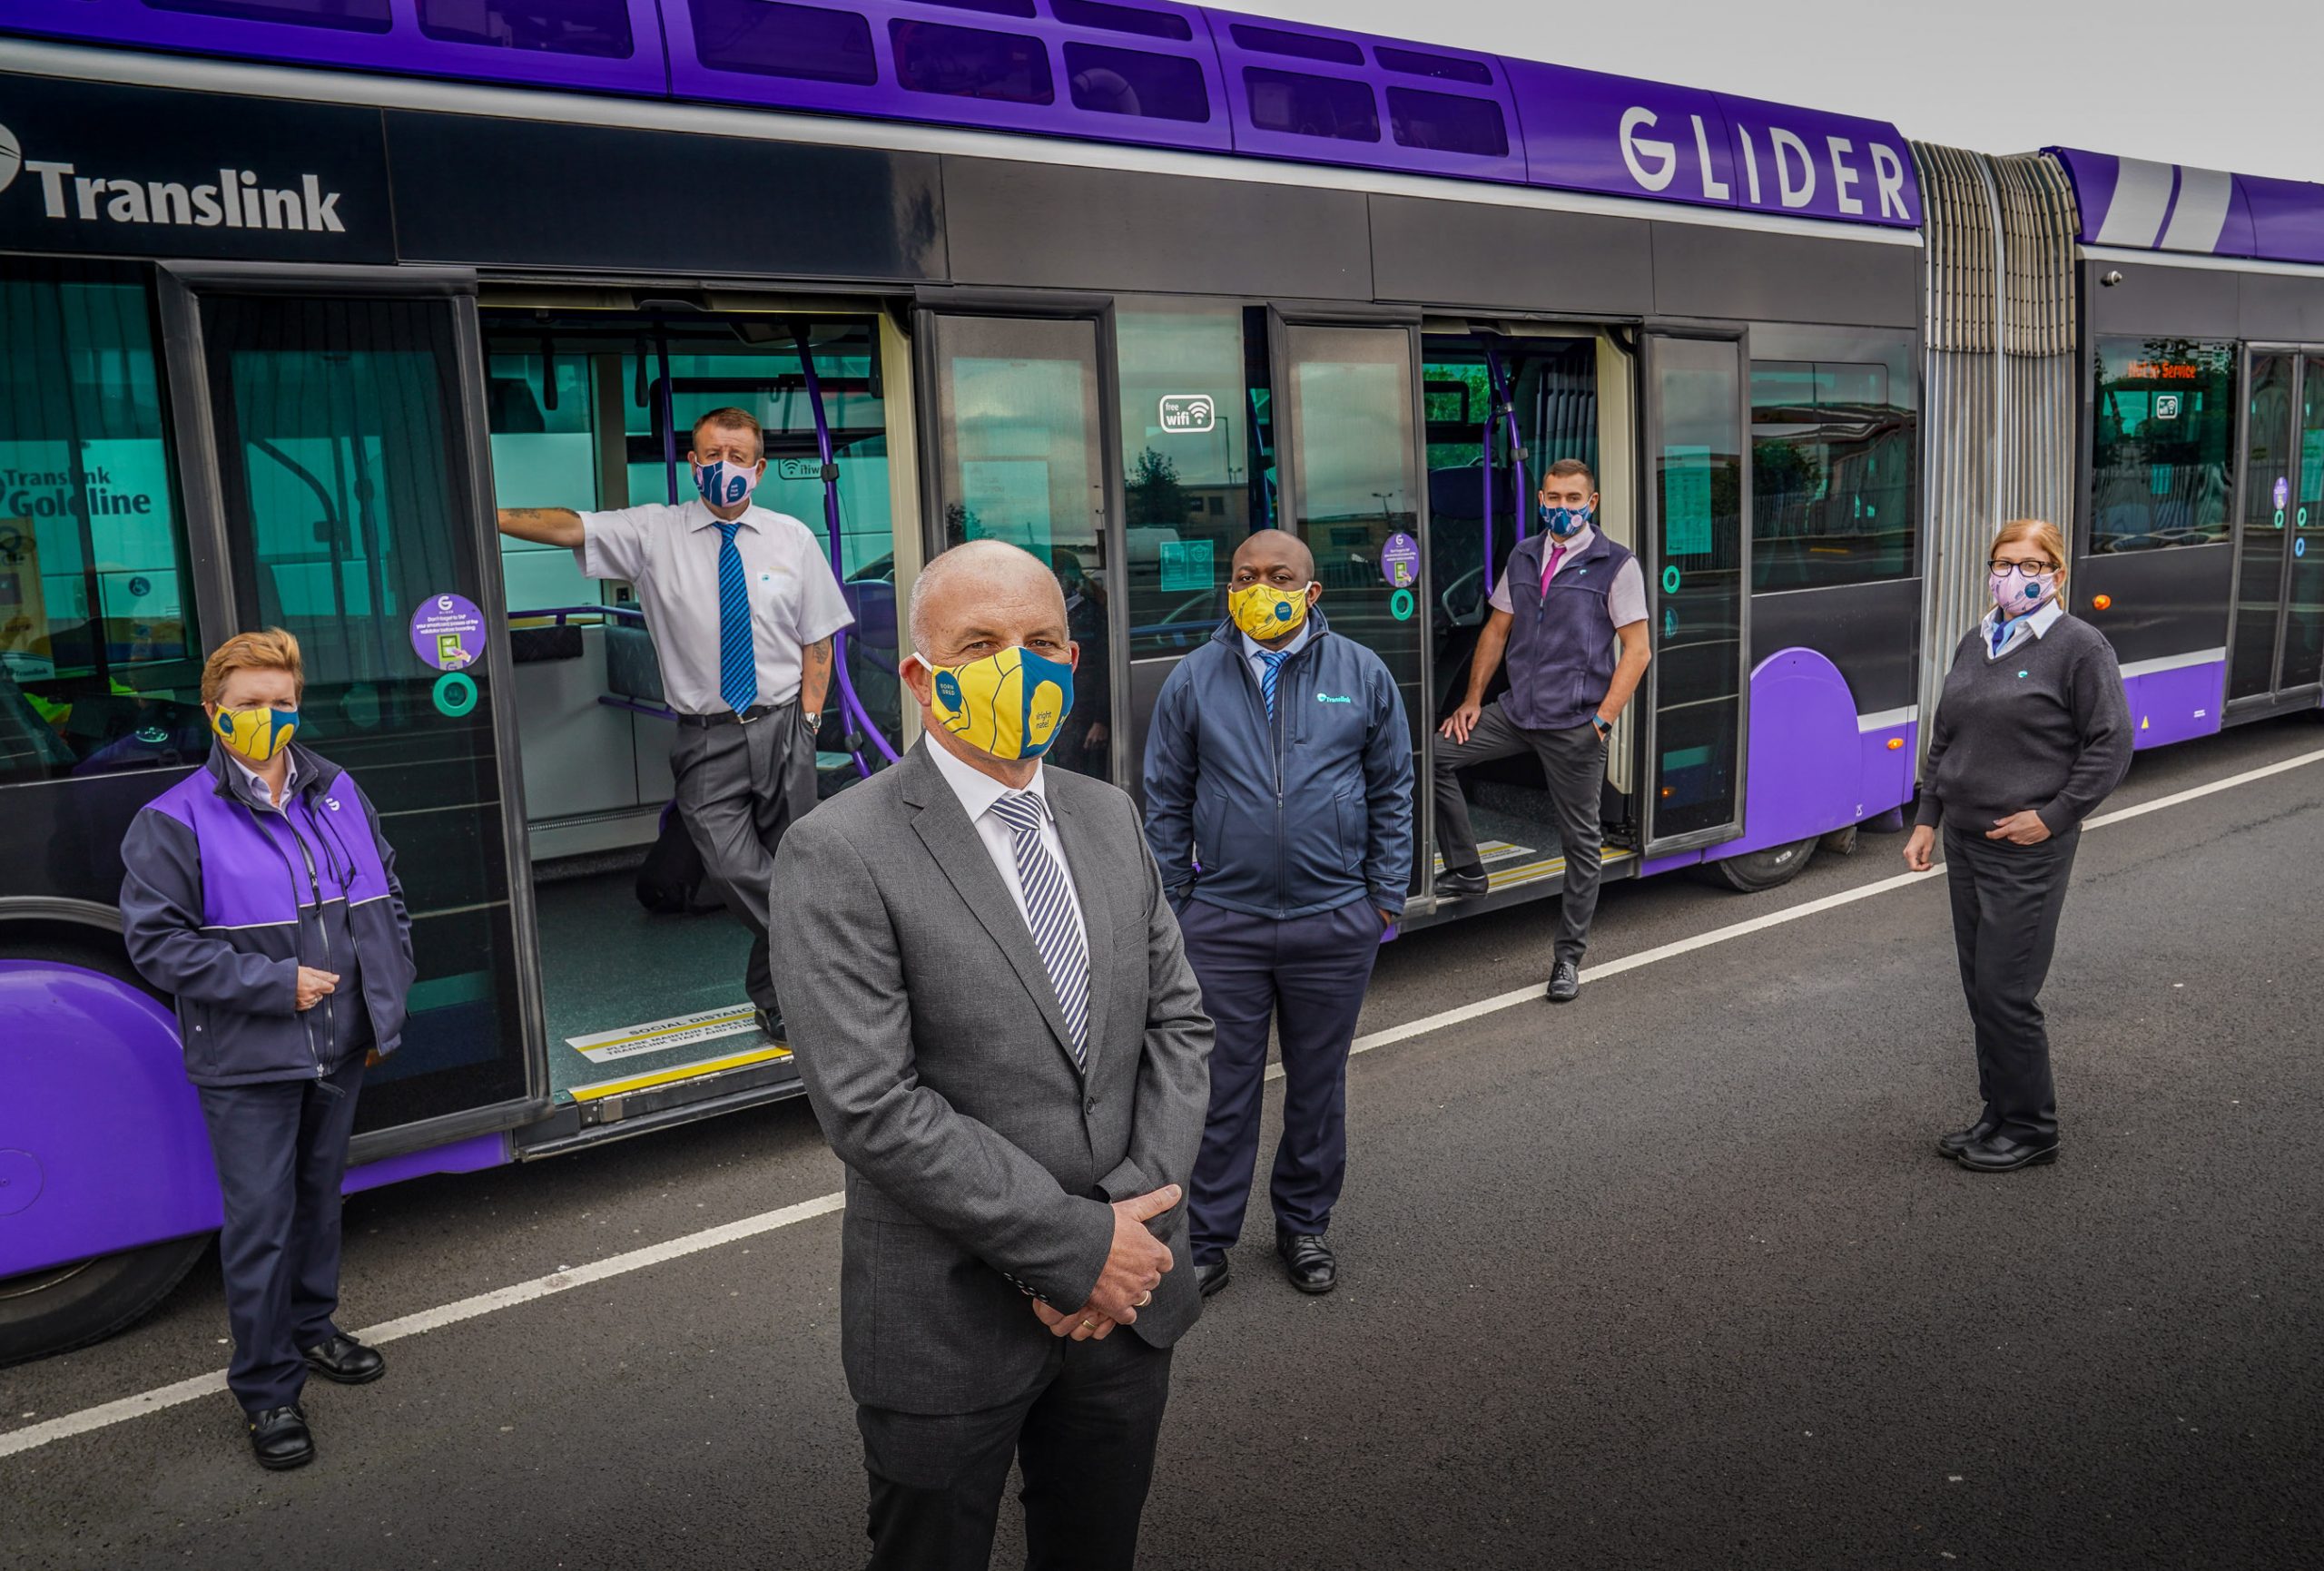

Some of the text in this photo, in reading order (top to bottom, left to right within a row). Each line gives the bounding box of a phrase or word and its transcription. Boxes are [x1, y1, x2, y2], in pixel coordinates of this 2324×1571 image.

[1619, 105, 1911, 220] GLIDER
[25, 160, 346, 232] Translink
[2162, 361, 2196, 378] Service
[1165, 402, 1179, 411] free
[1166, 411, 1190, 426] wifi
[4, 466, 112, 486] Translnk
[606, 1039, 649, 1051] PLEASE
[714, 1020, 741, 1029] SAFE
[629, 1022, 686, 1035] SOCIAL
[670, 1033, 702, 1043] STAFF
